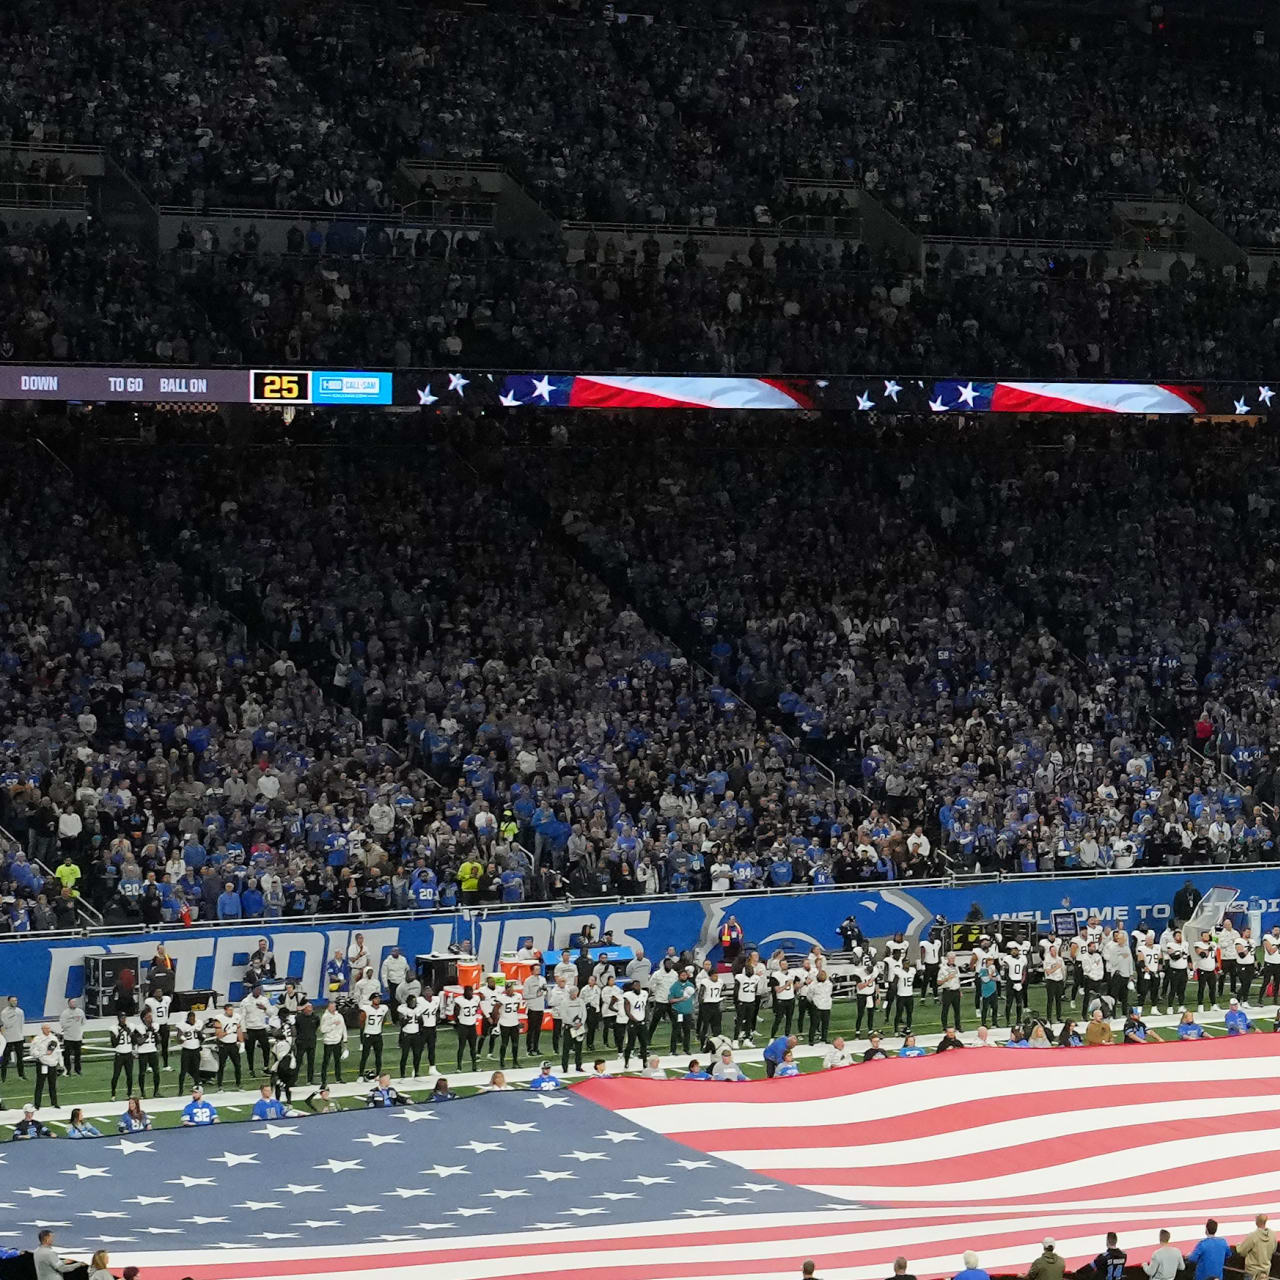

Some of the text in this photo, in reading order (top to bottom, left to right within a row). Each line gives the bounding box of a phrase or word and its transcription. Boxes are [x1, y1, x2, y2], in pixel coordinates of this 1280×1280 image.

[20, 375, 59, 392] DOWN
[108, 376, 144, 393] TO GO
[160, 377, 208, 394] BALL ON
[263, 375, 300, 399] 25
[1136, 904, 1171, 920] TO
